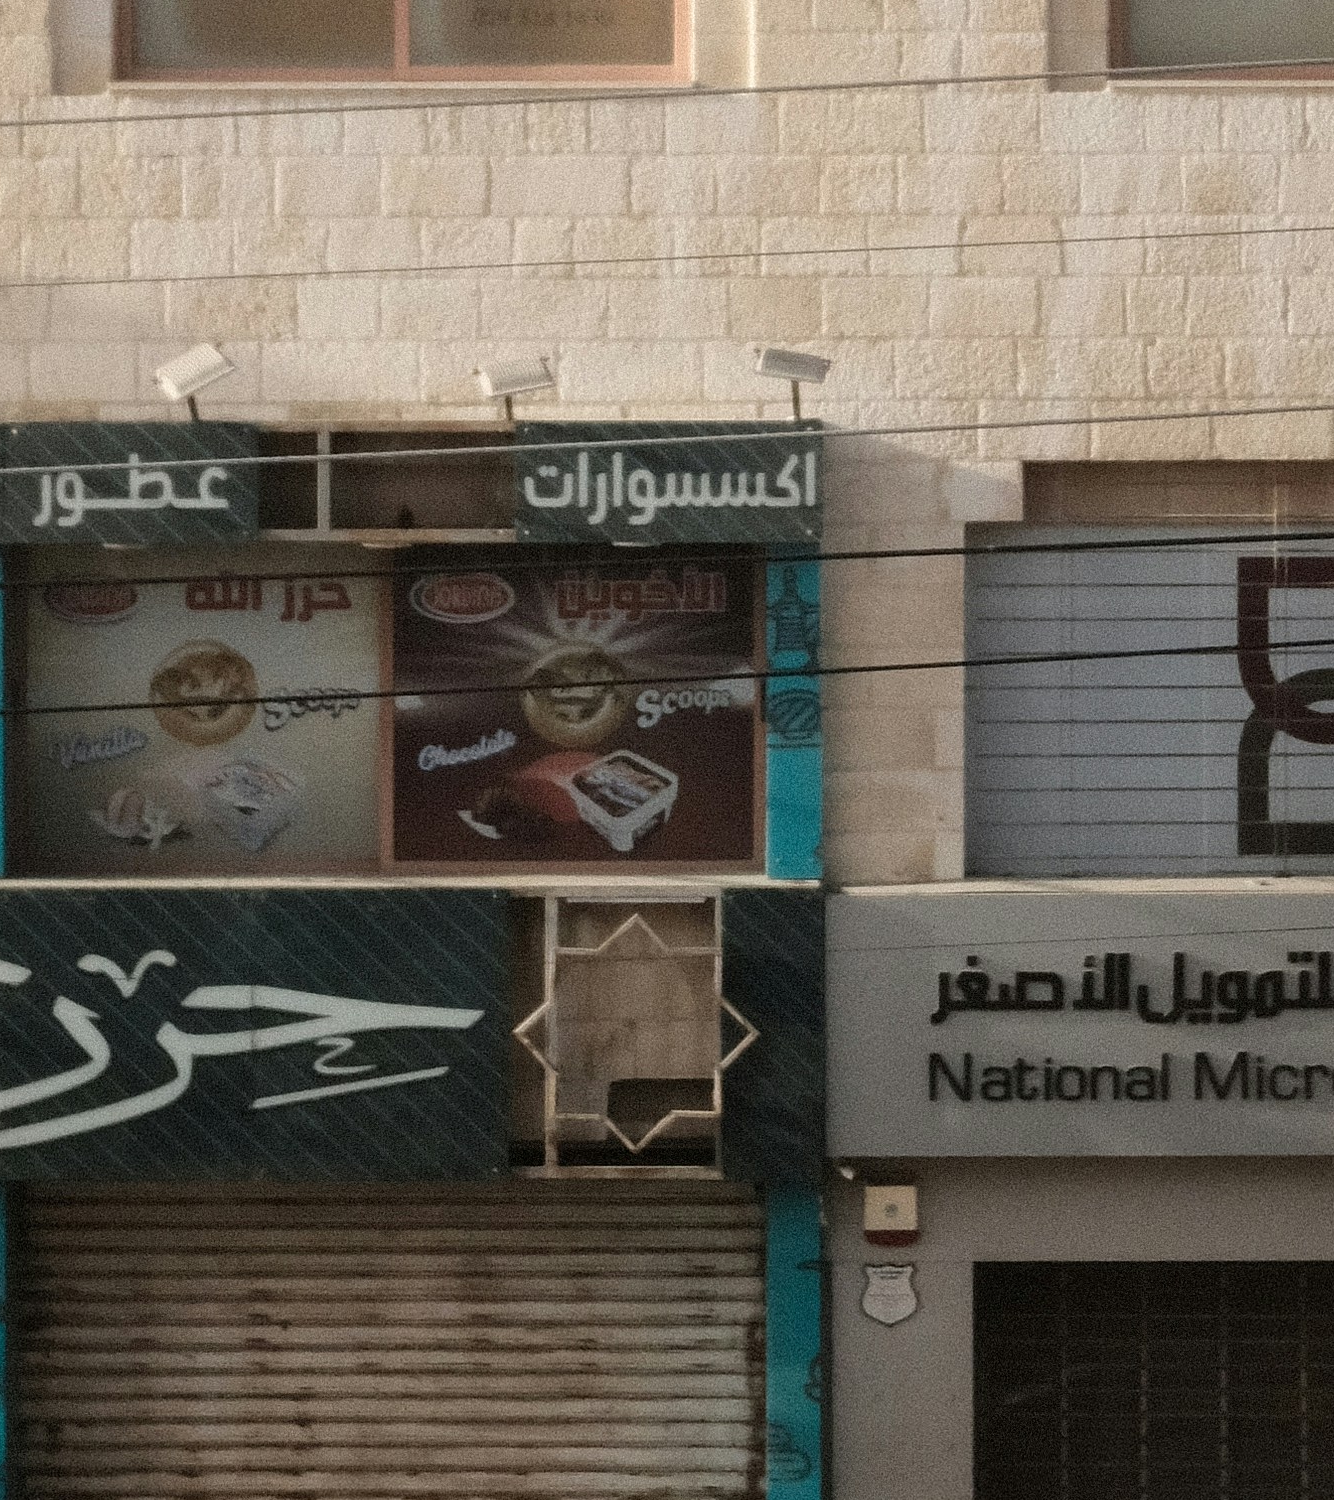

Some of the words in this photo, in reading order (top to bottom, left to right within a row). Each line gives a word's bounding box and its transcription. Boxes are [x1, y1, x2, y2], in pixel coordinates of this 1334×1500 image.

[31, 455, 231, 526] عطور
[523, 450, 817, 526] اكسسوارات
[185, 569, 263, 612] الله
[280, 577, 352, 623] حرز
[416, 727, 519, 773] Chocolate
[930, 950, 1130, 1026] الأصغر
[928, 1052, 1171, 1102] National
